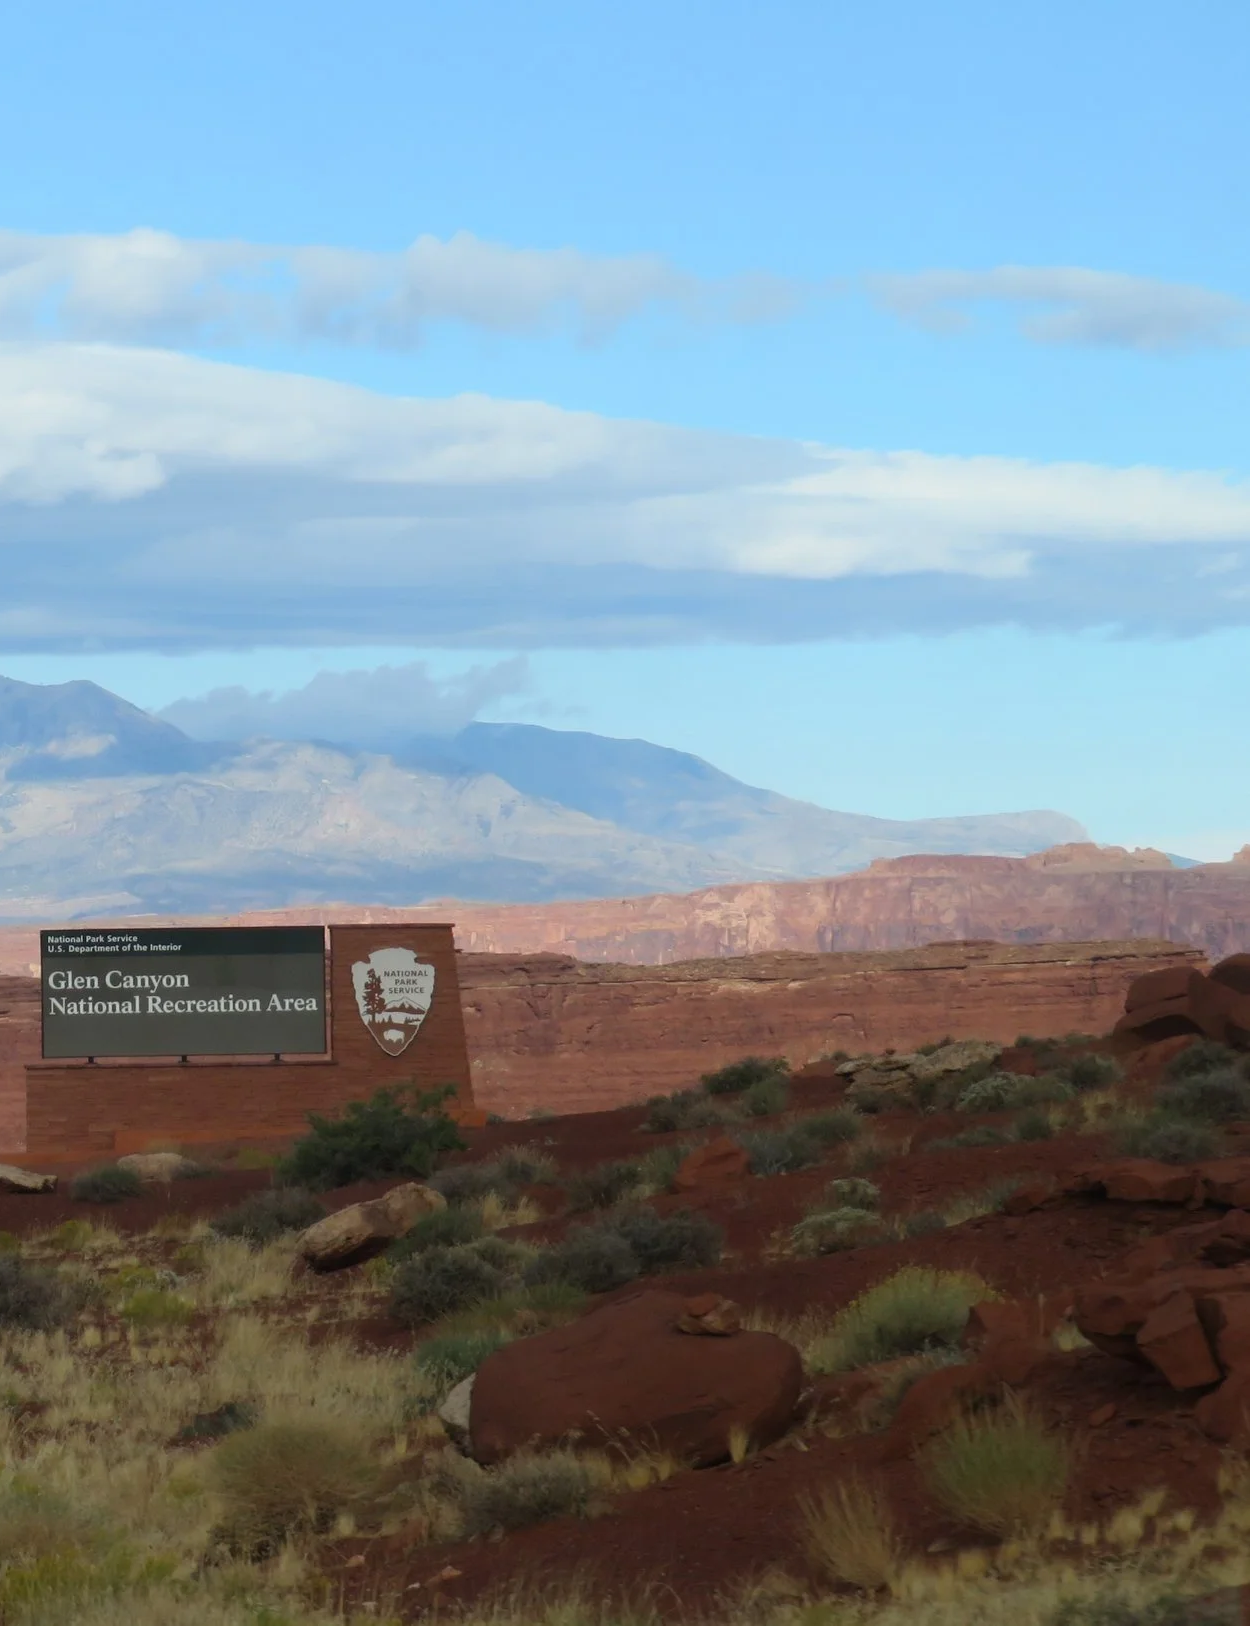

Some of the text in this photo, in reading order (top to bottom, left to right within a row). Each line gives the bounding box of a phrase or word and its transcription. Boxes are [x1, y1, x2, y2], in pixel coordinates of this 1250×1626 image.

[47, 935, 83, 943] National
[107, 934, 138, 942] Service
[68, 945, 119, 954] Department
[121, 943, 131, 951] of
[150, 943, 182, 951] Interior
[48, 970, 190, 992] Glen Canyon
[49, 994, 318, 1015] National Recreation Area
